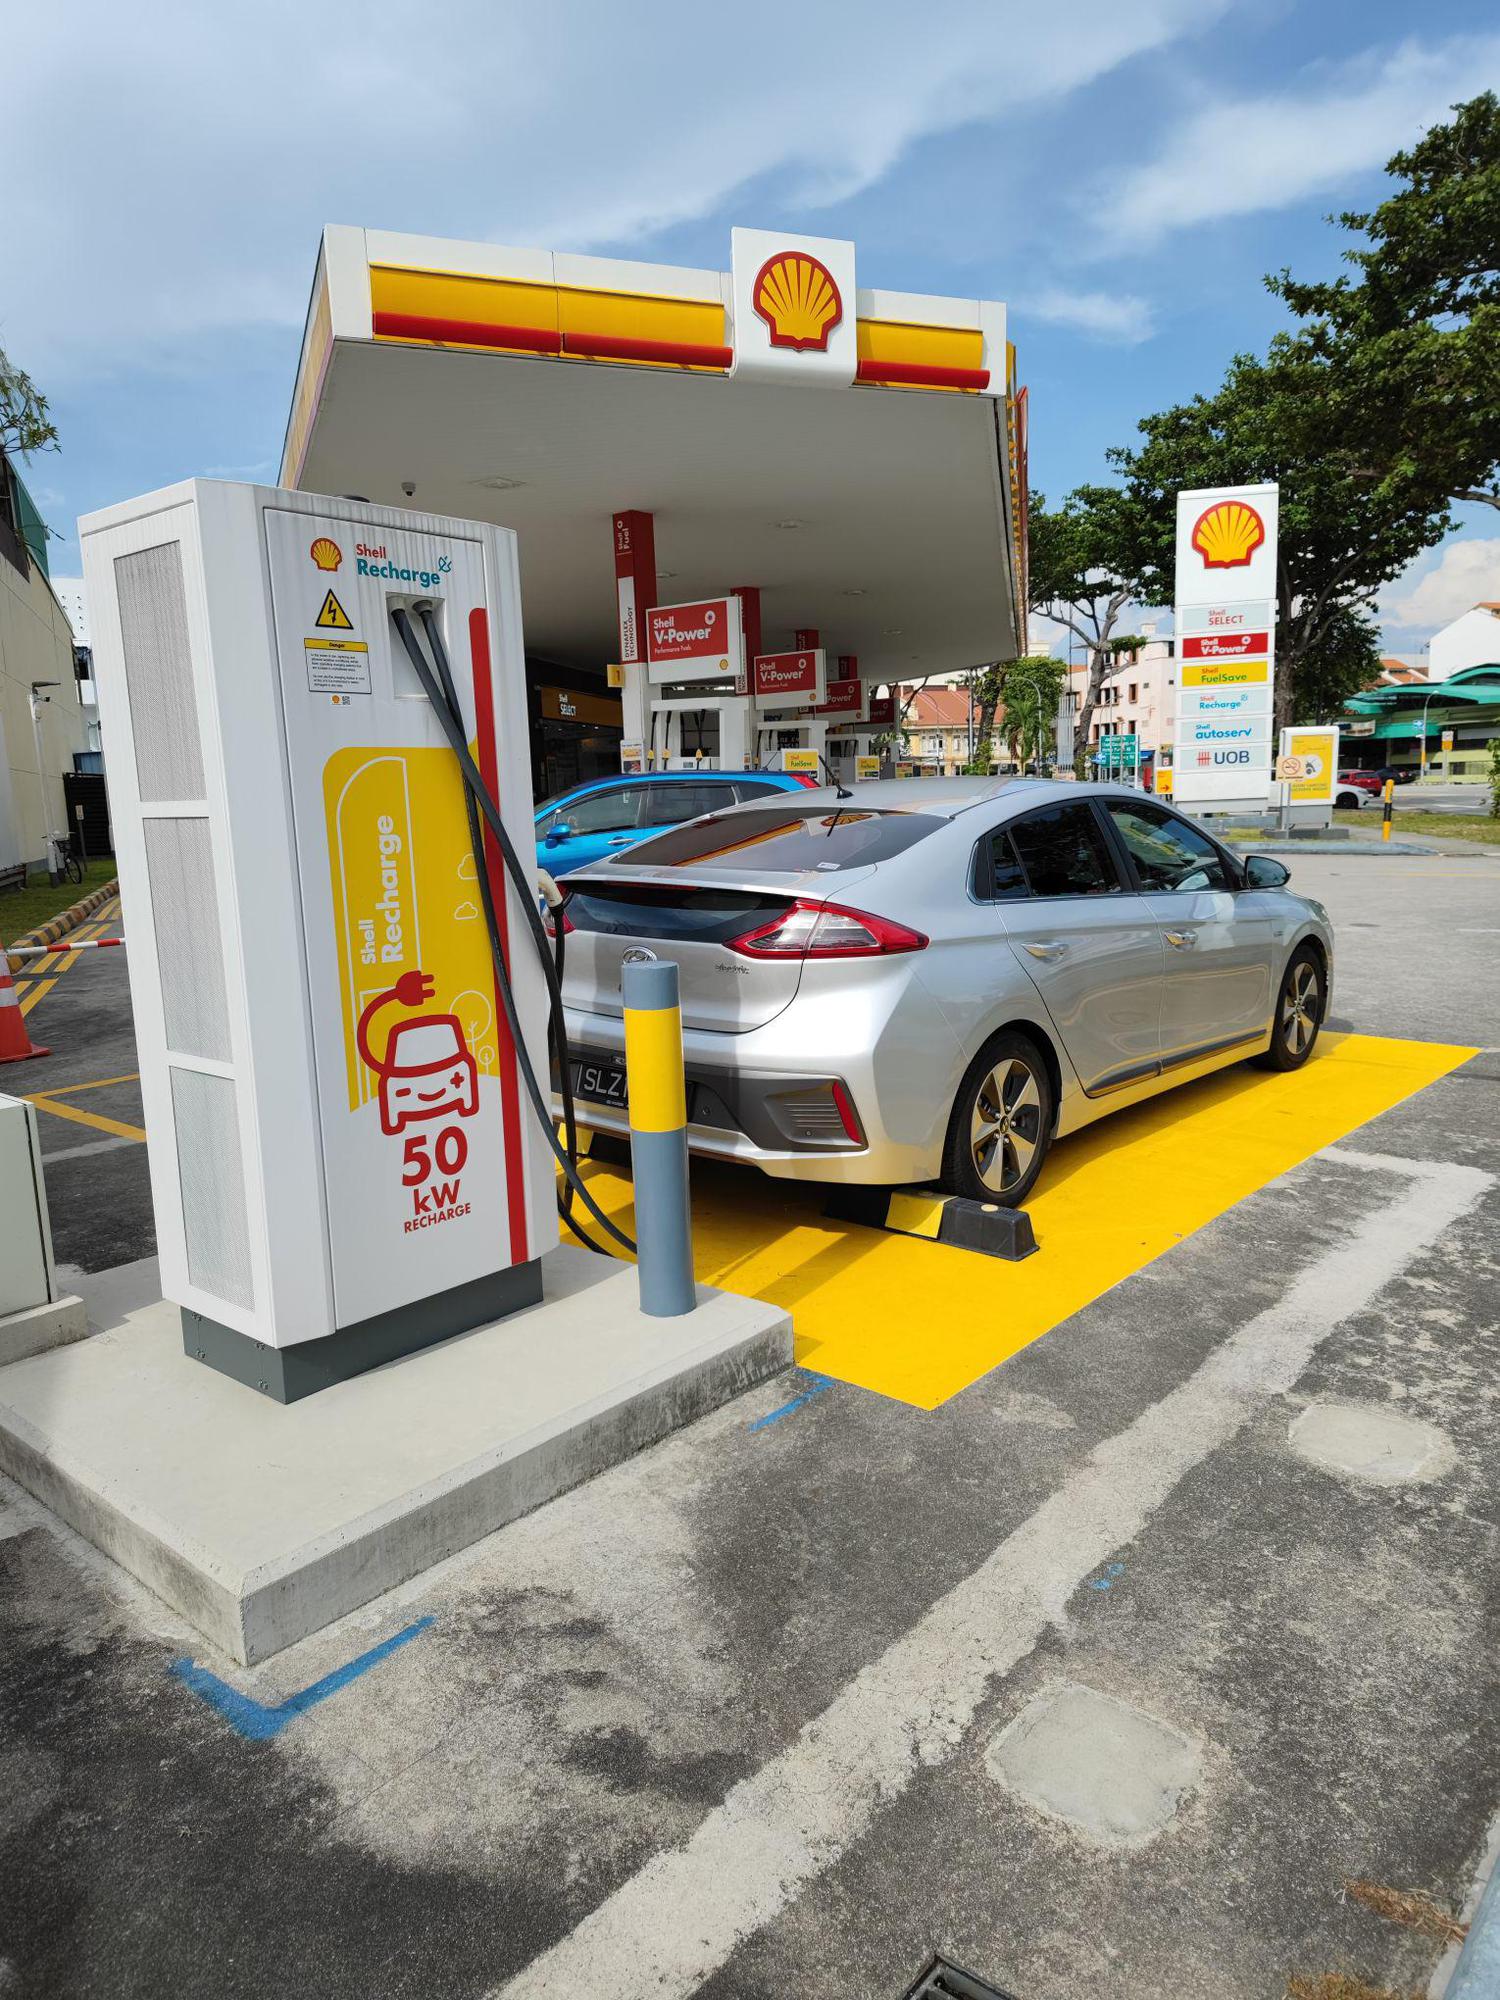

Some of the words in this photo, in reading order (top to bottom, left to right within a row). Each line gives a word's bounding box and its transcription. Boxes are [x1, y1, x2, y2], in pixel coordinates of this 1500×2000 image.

[622, 528, 630, 549] Fuel
[356, 544, 387, 559] Shell
[356, 559, 441, 588] Recharge
[653, 616, 674, 629] Shell
[1208, 615, 1244, 626] SELECT
[654, 627, 711, 645] V-Power
[1201, 646, 1248, 655] V-Power
[759, 662, 775, 671] Shell
[760, 670, 803, 682] V-Power
[1201, 673, 1248, 682] FuelSave
[827, 694, 852, 704] Power
[1199, 701, 1241, 709] Recharge
[1195, 728, 1252, 740] autoserv
[1214, 750, 1250, 765] UOB
[375, 815, 404, 964] Recharge
[358, 919, 377, 965] Shell
[402, 1126, 468, 1187] 50
[413, 1179, 460, 1216] kW
[404, 1203, 471, 1233] RECHARGE
